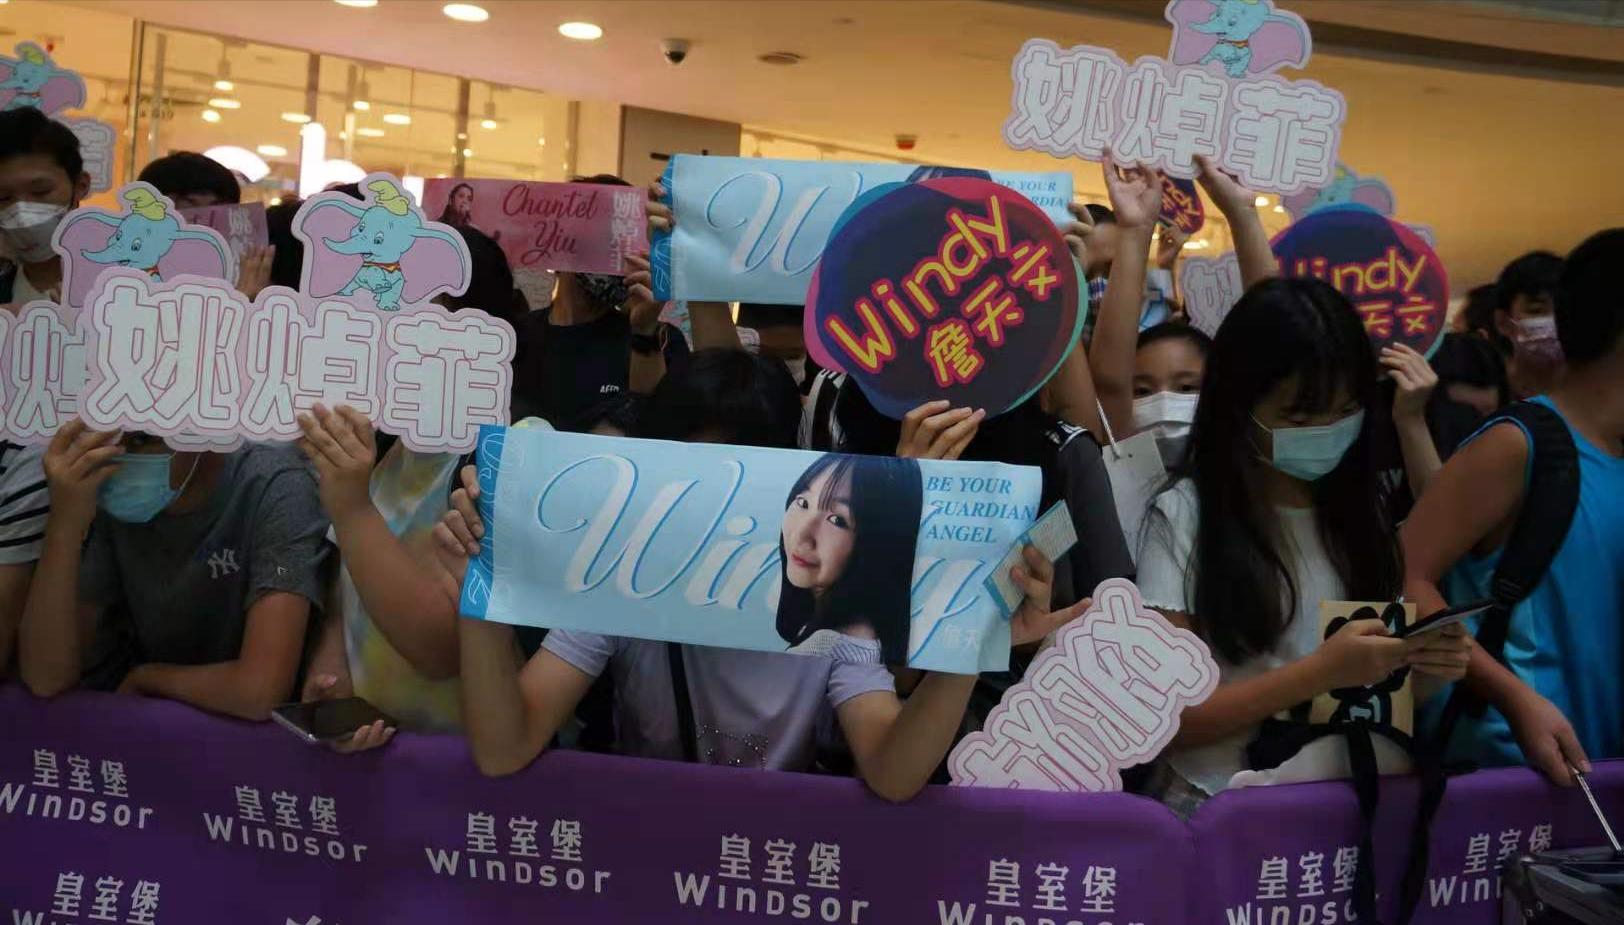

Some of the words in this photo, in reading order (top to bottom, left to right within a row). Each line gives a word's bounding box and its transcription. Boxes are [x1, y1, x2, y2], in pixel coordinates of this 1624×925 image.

[1007, 48, 1340, 186] 姚焯菲
[502, 184, 598, 221] Chantel
[520, 220, 577, 265] Yiu
[827, 194, 1007, 370] Windy
[1360, 296, 1434, 335] 天文
[86, 284, 504, 439] 姚焯菲
[927, 476, 953, 492] BE
[959, 477, 1012, 495] YOUR
[534, 454, 981, 662] Winy
[926, 525, 998, 543] ANGEL
[32, 749, 129, 798] 皇室堡
[235, 785, 342, 836] 皇室堡
[466, 811, 584, 862] 皇室堡
[717, 833, 842, 890] 皇室堡
[51, 871, 161, 925] 皇室堡
[985, 857, 1118, 913] 皇室堡
